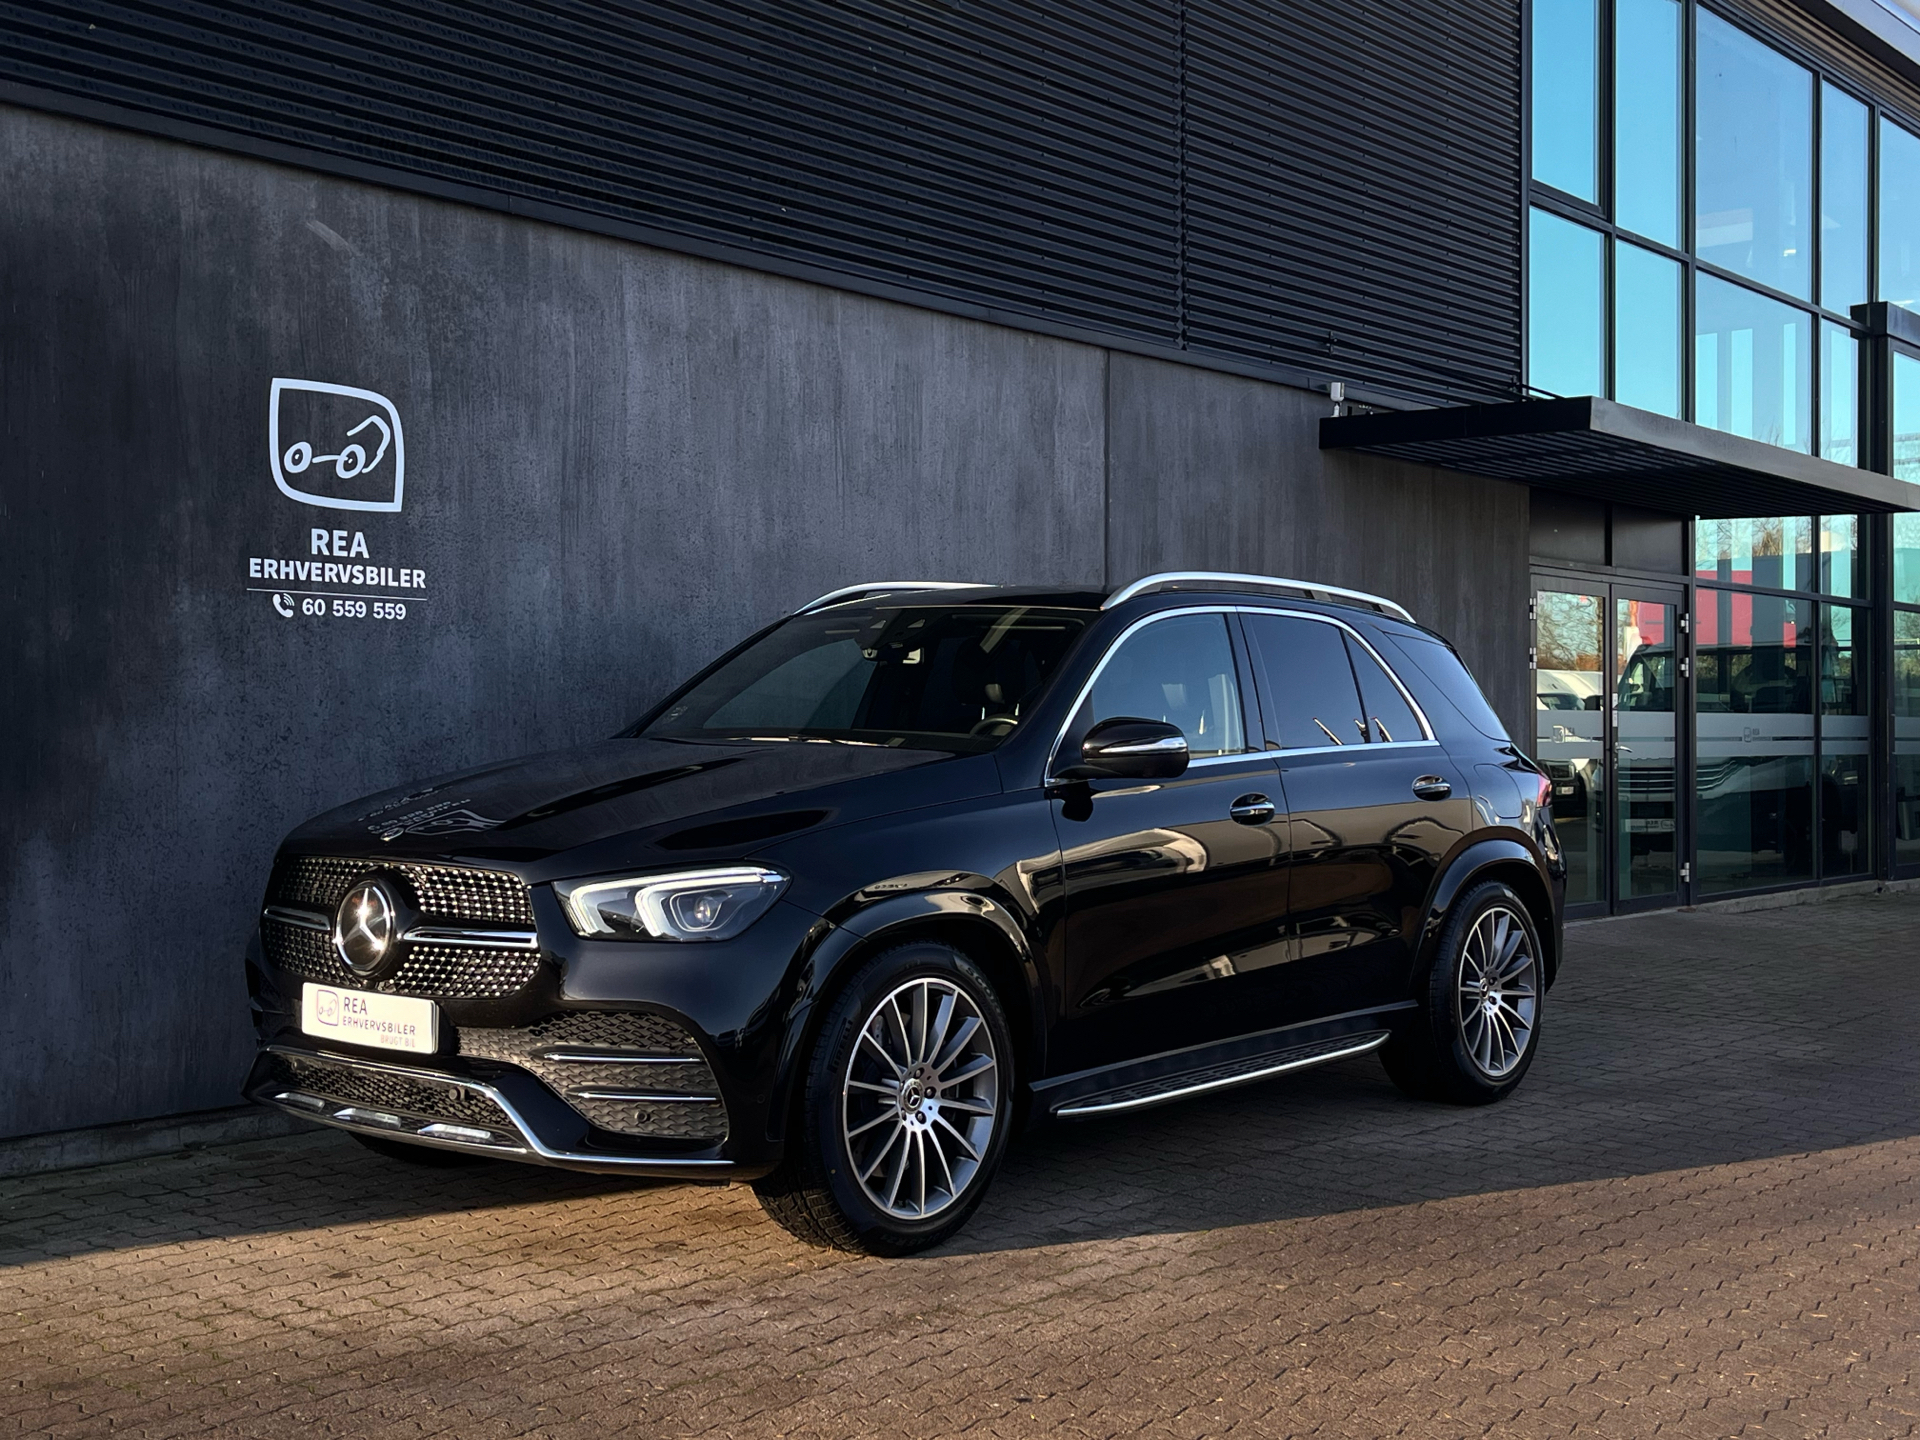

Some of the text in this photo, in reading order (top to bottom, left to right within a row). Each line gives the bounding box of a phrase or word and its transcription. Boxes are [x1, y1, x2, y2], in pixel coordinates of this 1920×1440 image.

[311, 528, 369, 558] REA
[249, 557, 426, 588] ERHVERVSBILER
[302, 598, 406, 620] 60 559 559
[343, 996, 368, 1015] REA
[342, 1015, 416, 1036] ERHVERVSBILER
[380, 1034, 416, 1048] BRUGT BIL
[828, 1016, 853, 1074] PIRELLI
